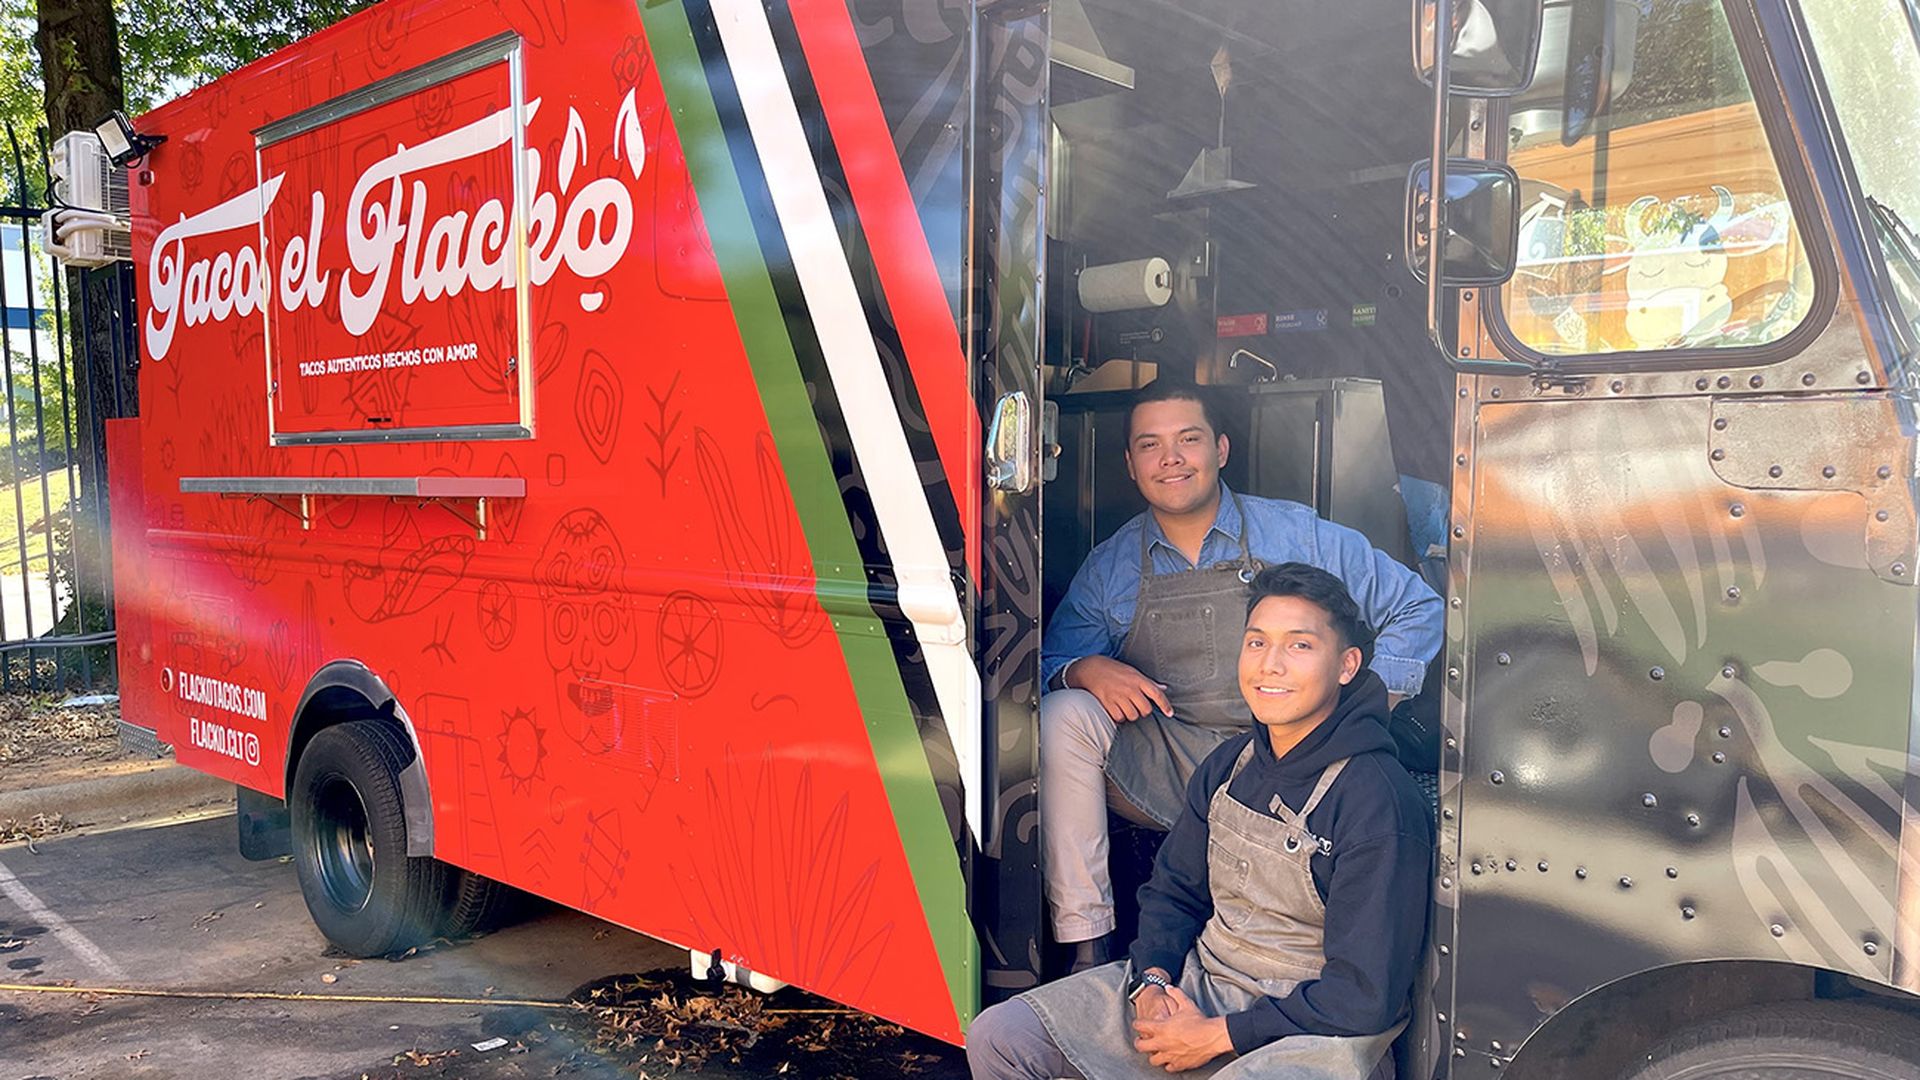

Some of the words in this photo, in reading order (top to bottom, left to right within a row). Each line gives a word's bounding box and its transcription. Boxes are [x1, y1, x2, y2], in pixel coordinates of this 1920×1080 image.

[146, 172, 285, 361] Tacos
[280, 190, 329, 312] el
[339, 95, 635, 336] Flacko
[300, 361, 325, 376] TACOS
[327, 355, 381, 373] AUTENTICOS
[382, 349, 421, 368] HECHOS
[423, 347, 444, 364] CON
[446, 343, 478, 362] AMOR
[179, 671, 267, 721] FLACKOTACOS.COM
[190, 717, 244, 760] FLACKO.CLT
